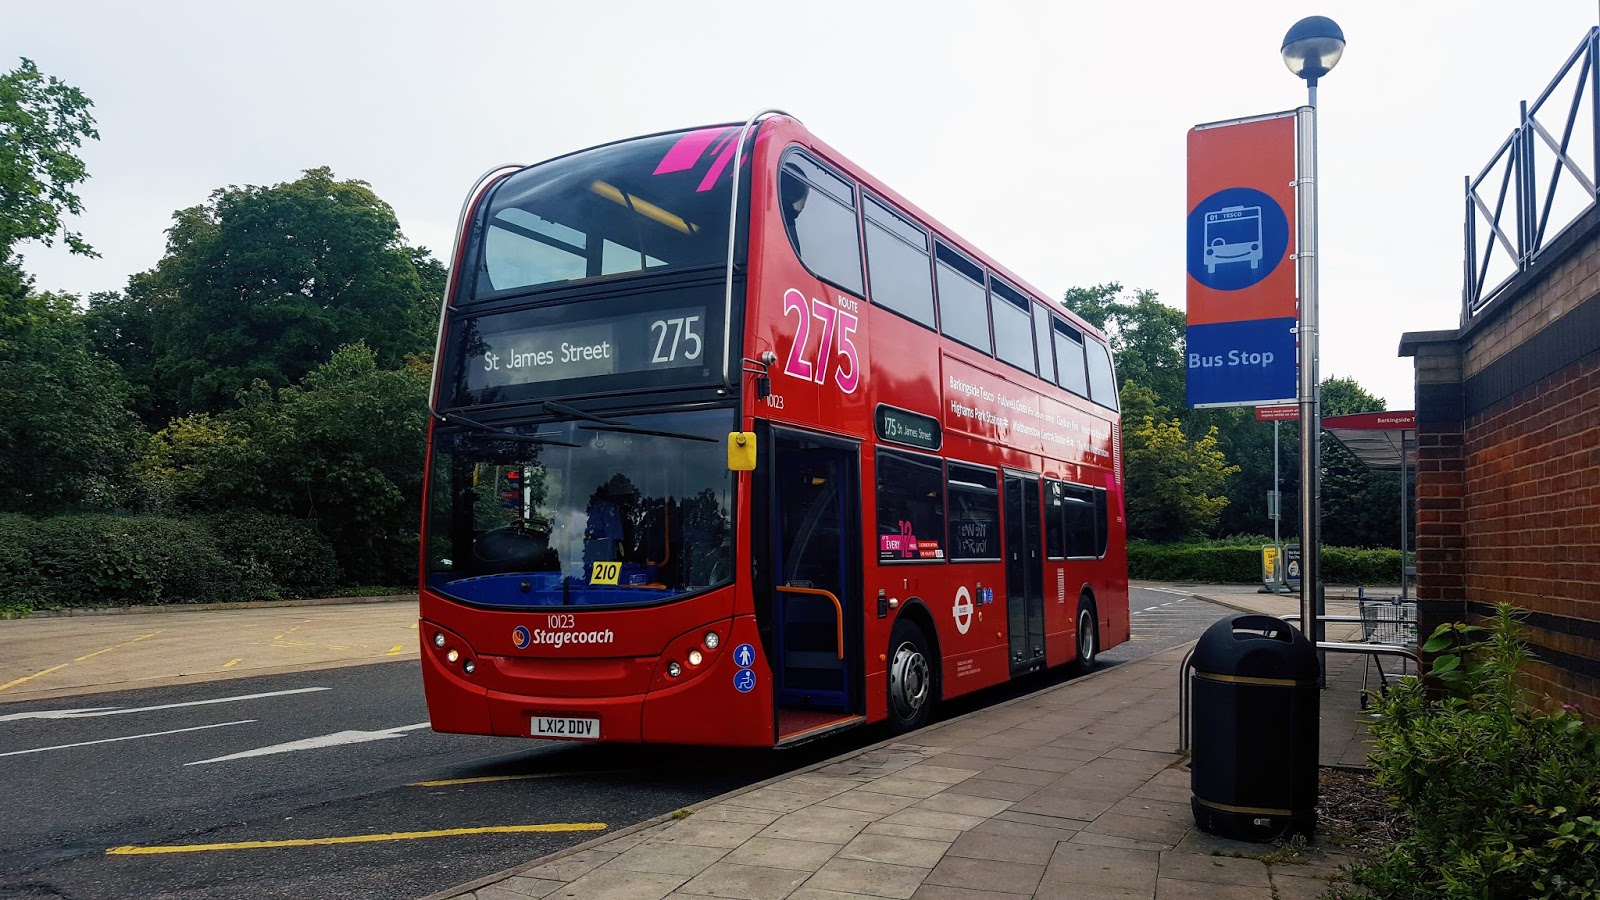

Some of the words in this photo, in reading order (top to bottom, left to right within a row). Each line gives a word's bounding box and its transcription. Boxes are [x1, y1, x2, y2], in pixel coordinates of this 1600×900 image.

[1222, 210, 1243, 219] TESCO
[838, 295, 859, 314] ROUTE
[651, 315, 702, 364] 275
[783, 287, 860, 394] 275
[484, 351, 500, 372] St
[506, 348, 554, 370] James
[560, 340, 610, 364] Street
[1188, 353, 1223, 369] Bus
[1227, 349, 1274, 368] Stop
[949, 375, 980, 398] Barkingside
[979, 386, 995, 402] Tesco
[950, 400, 975, 418] Highams
[975, 408, 986, 422] Park
[903, 425, 918, 438] James
[918, 428, 932, 441] Street
[886, 540, 900, 549] EVERY
[898, 520, 913, 558] 12
[594, 564, 617, 581] 210
[547, 614, 575, 630] 10123
[533, 628, 614, 648] Stagecoach
[538, 718, 566, 734] LX12
[568, 719, 593, 735] DDV
